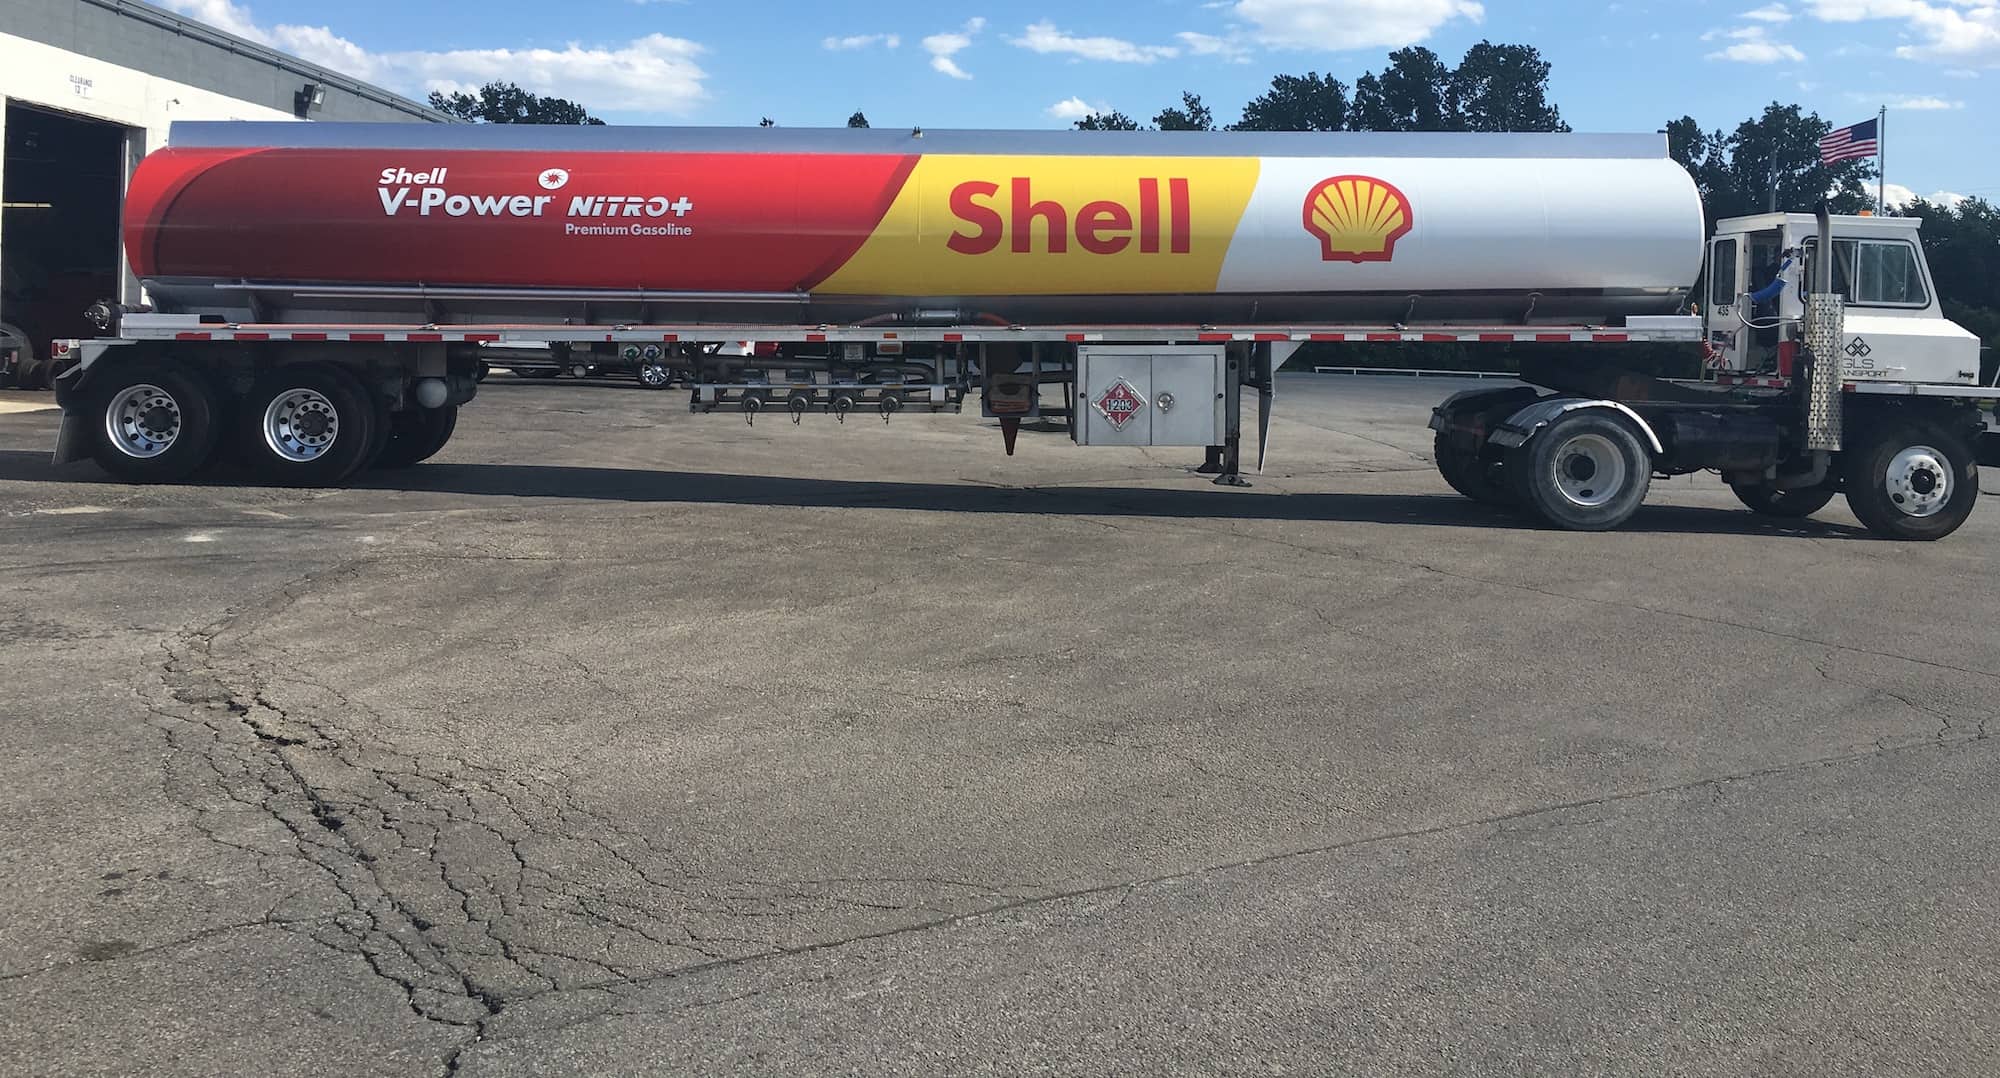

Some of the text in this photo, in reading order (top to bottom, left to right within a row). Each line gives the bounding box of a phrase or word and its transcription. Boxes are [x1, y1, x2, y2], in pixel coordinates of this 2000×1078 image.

[379, 167, 448, 185] Shell
[377, 187, 552, 217] V-Power
[946, 176, 1191, 255] Shell
[565, 223, 693, 236] Premium Gasoline
[1108, 399, 1133, 411] 1203
